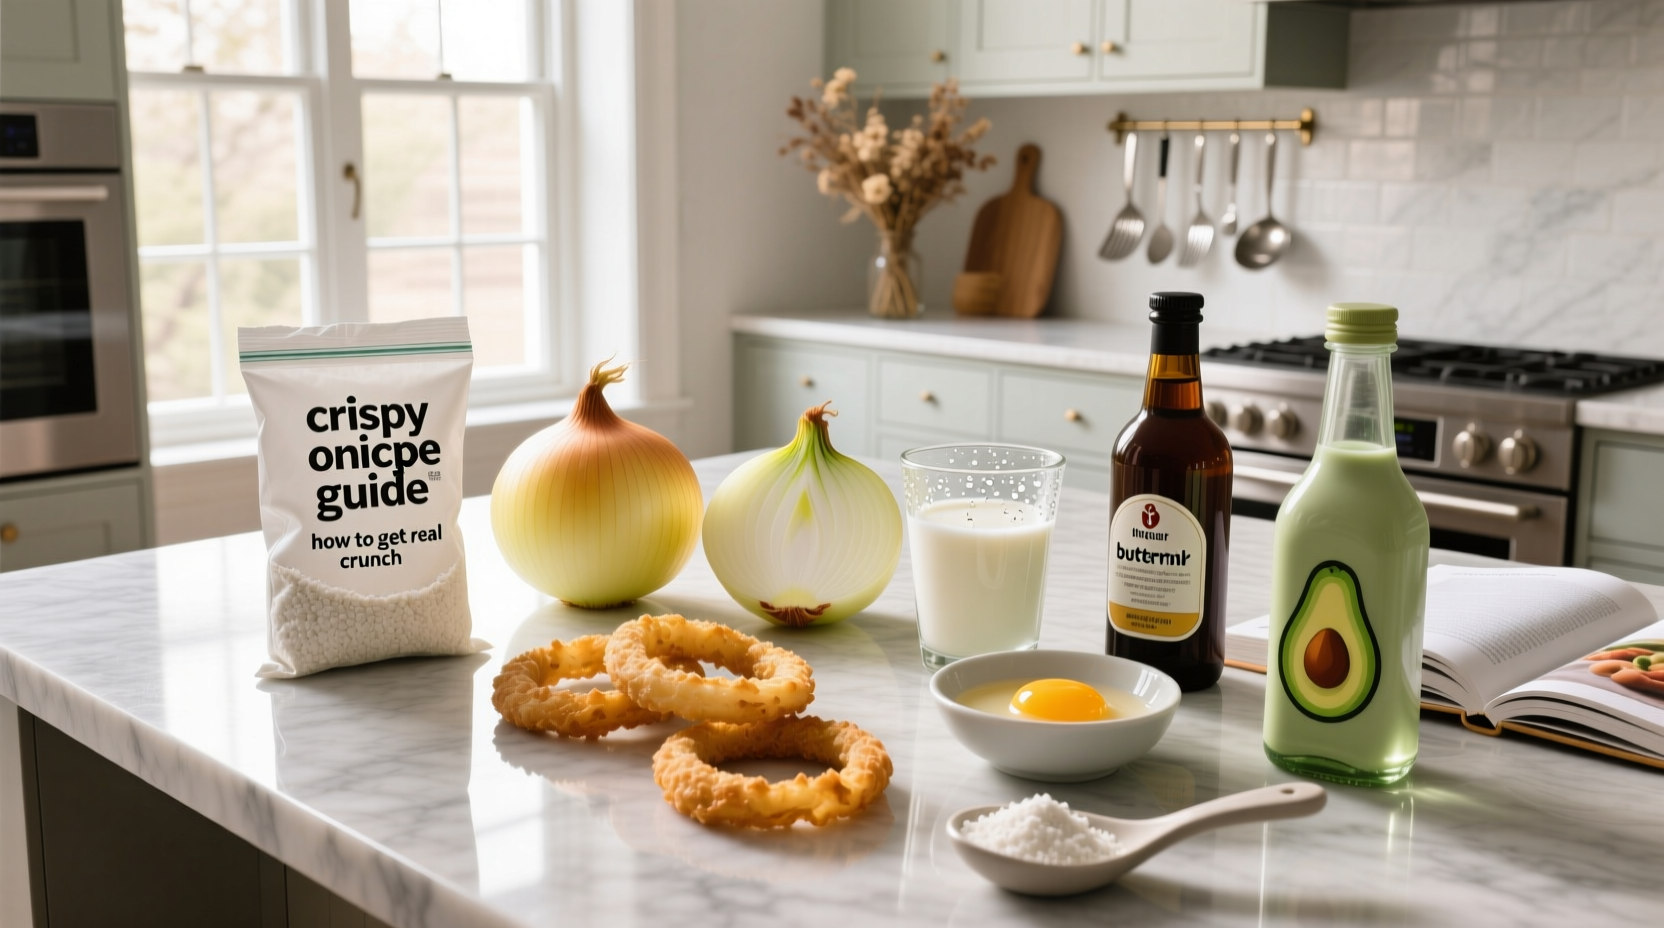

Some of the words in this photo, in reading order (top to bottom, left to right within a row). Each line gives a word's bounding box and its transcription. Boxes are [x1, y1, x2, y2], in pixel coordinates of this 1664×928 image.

[307, 395, 429, 438] crispy
[308, 434, 441, 472] onicpe
[316, 468, 429, 522] guide
[312, 533, 350, 550] how
[354, 532, 374, 547] to
[377, 528, 407, 551] get
[411, 523, 442, 543] real
[340, 549, 402, 569] crunch
